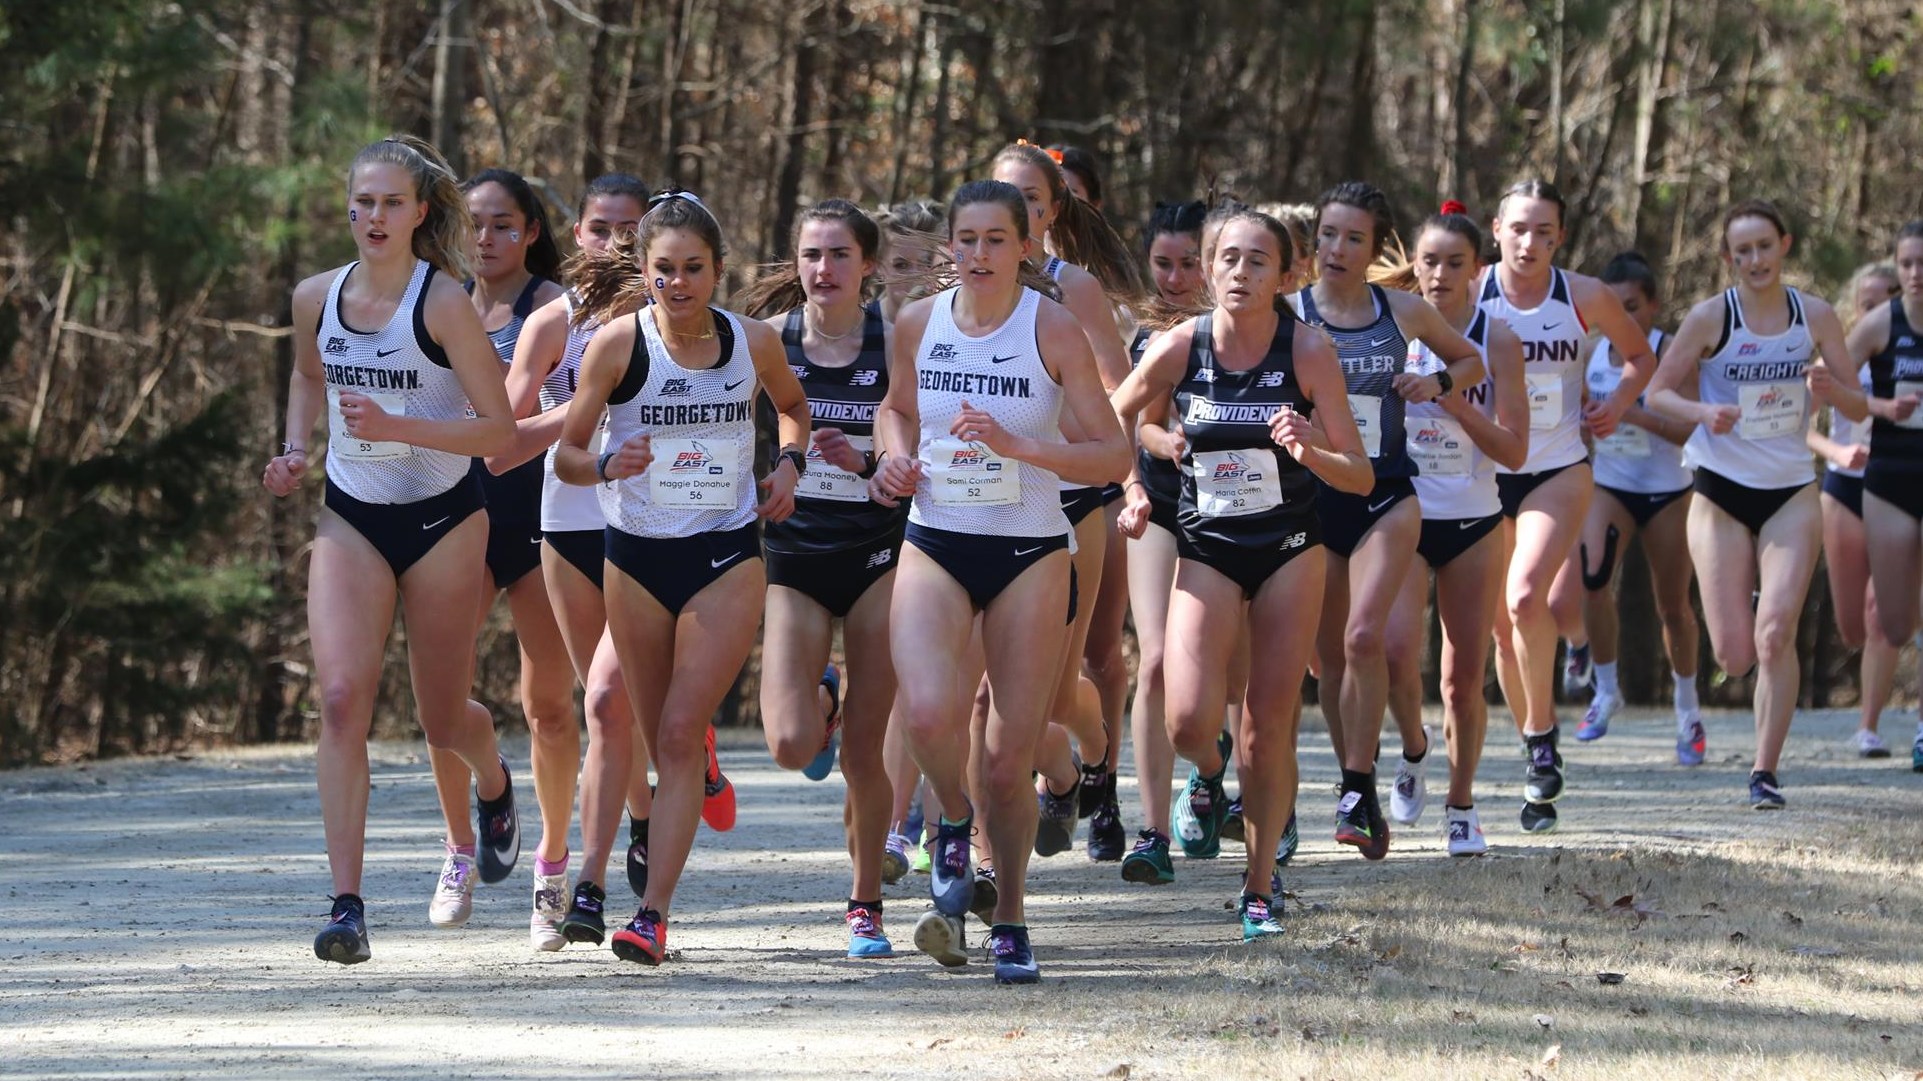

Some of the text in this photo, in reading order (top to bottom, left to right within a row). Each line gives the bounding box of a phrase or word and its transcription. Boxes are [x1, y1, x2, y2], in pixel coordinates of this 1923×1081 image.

[350, 210, 357, 222] G
[1037, 208, 1045, 218] V
[655, 277, 665, 289] G
[328, 336, 346, 345] BIG
[325, 344, 350, 352] EAST
[933, 343, 955, 351] BIG
[1521, 339, 1578, 362] ONN
[929, 351, 960, 359] EAST
[1338, 355, 1394, 374] TLER
[323, 363, 418, 389] ORGETOWN
[920, 369, 1030, 398] GEORGETOWN
[661, 385, 693, 393] EAST
[360, 443, 372, 452] 53
[677, 452, 704, 460] BIG
[672, 460, 710, 468] EAST
[951, 457, 986, 465] EAST
[1216, 463, 1240, 471] BIG
[801, 470, 856, 482] aura Mooney
[1214, 470, 1246, 478] EAST
[659, 480, 731, 489] Maggie Donahue
[946, 477, 1002, 485] Sami Corman
[820, 482, 833, 490] 88
[689, 490, 703, 500] 56
[967, 488, 981, 497] 52
[1216, 489, 1236, 497] Maria
[1232, 499, 1246, 508] 82
